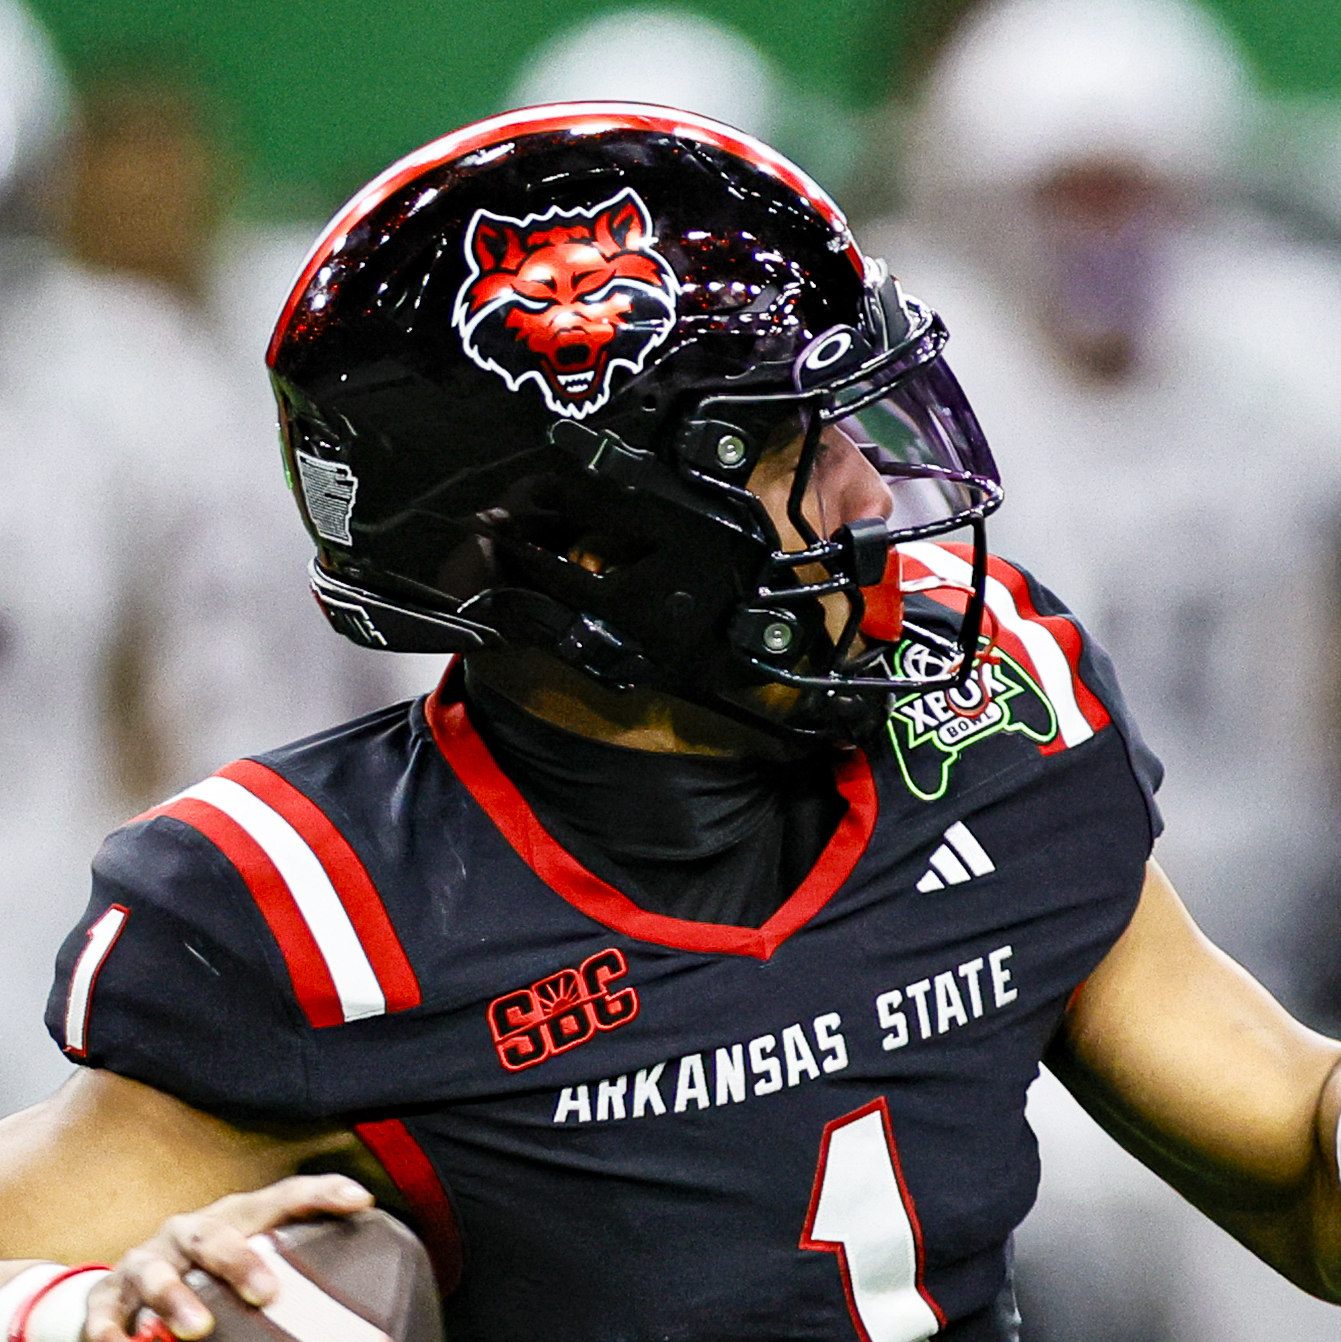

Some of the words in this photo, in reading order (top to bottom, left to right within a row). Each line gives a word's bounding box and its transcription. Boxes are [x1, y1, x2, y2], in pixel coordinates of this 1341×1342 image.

[62, 904, 130, 1057] 1
[487, 948, 640, 1072] SBC
[553, 1012, 848, 1124] ARKANSAS
[876, 945, 1019, 1051] STATE
